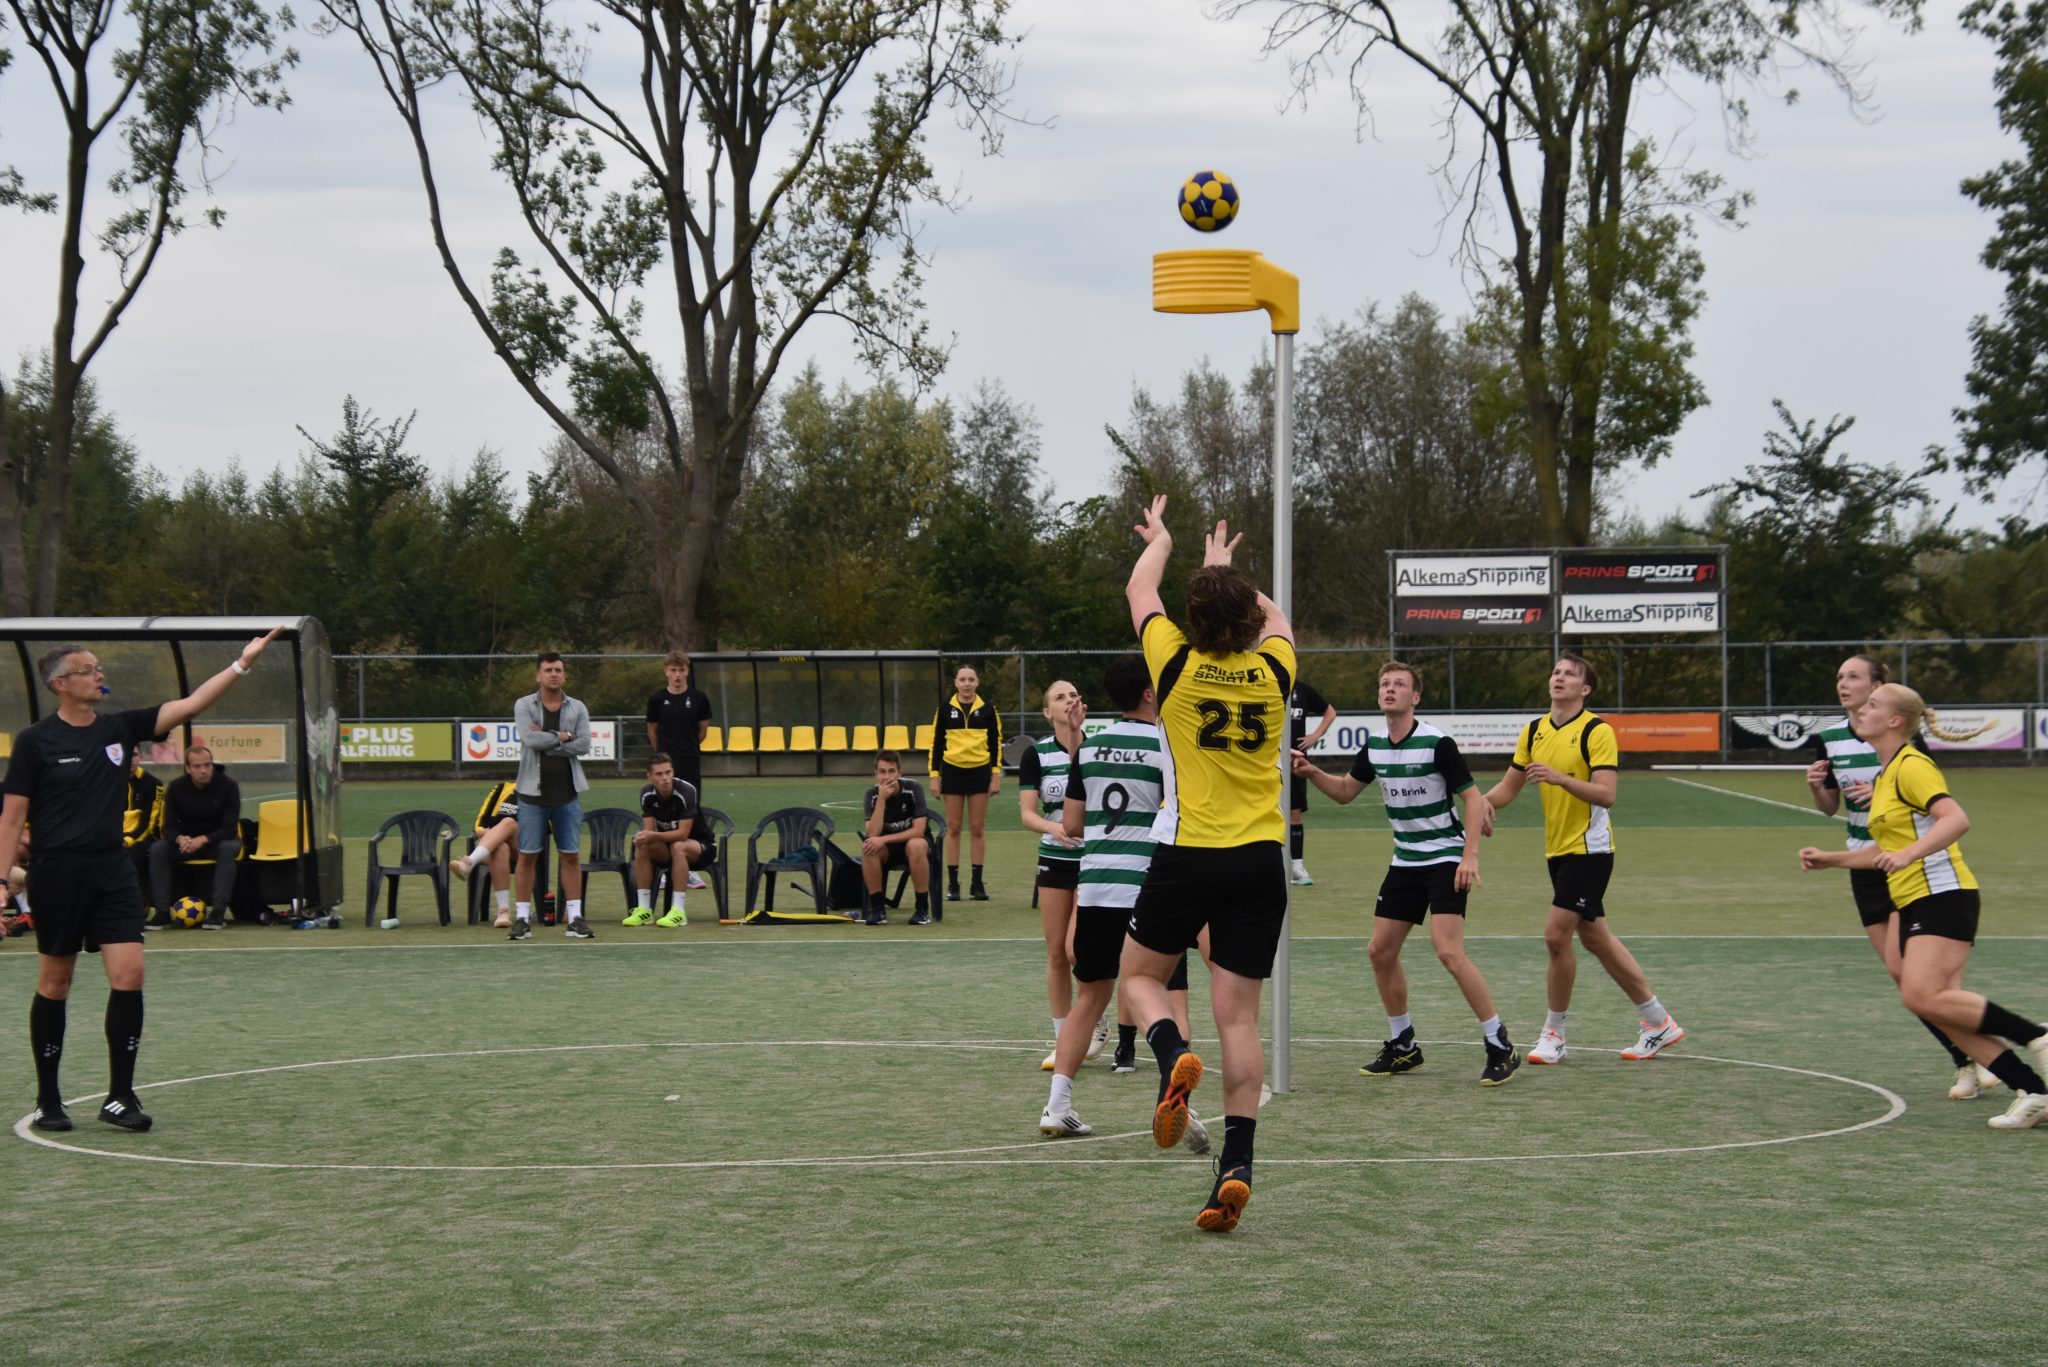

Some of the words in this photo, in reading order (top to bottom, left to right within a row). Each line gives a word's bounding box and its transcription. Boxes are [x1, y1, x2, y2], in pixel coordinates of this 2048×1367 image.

[1564, 565, 1626, 578] PRINS
[1627, 564, 1698, 578] SPORT
[1405, 608, 1462, 620] PRINS
[1462, 607, 1526, 620] SPORT
[1193, 670, 1247, 684] SPORT
[950, 710, 959, 718] 22
[1194, 698, 1269, 754] 25
[209, 735, 263, 748] fortune
[352, 727, 415, 743] PLUS
[1093, 747, 1148, 763] Houx
[1401, 786, 1427, 797] Brink
[1101, 782, 1131, 835] 9
